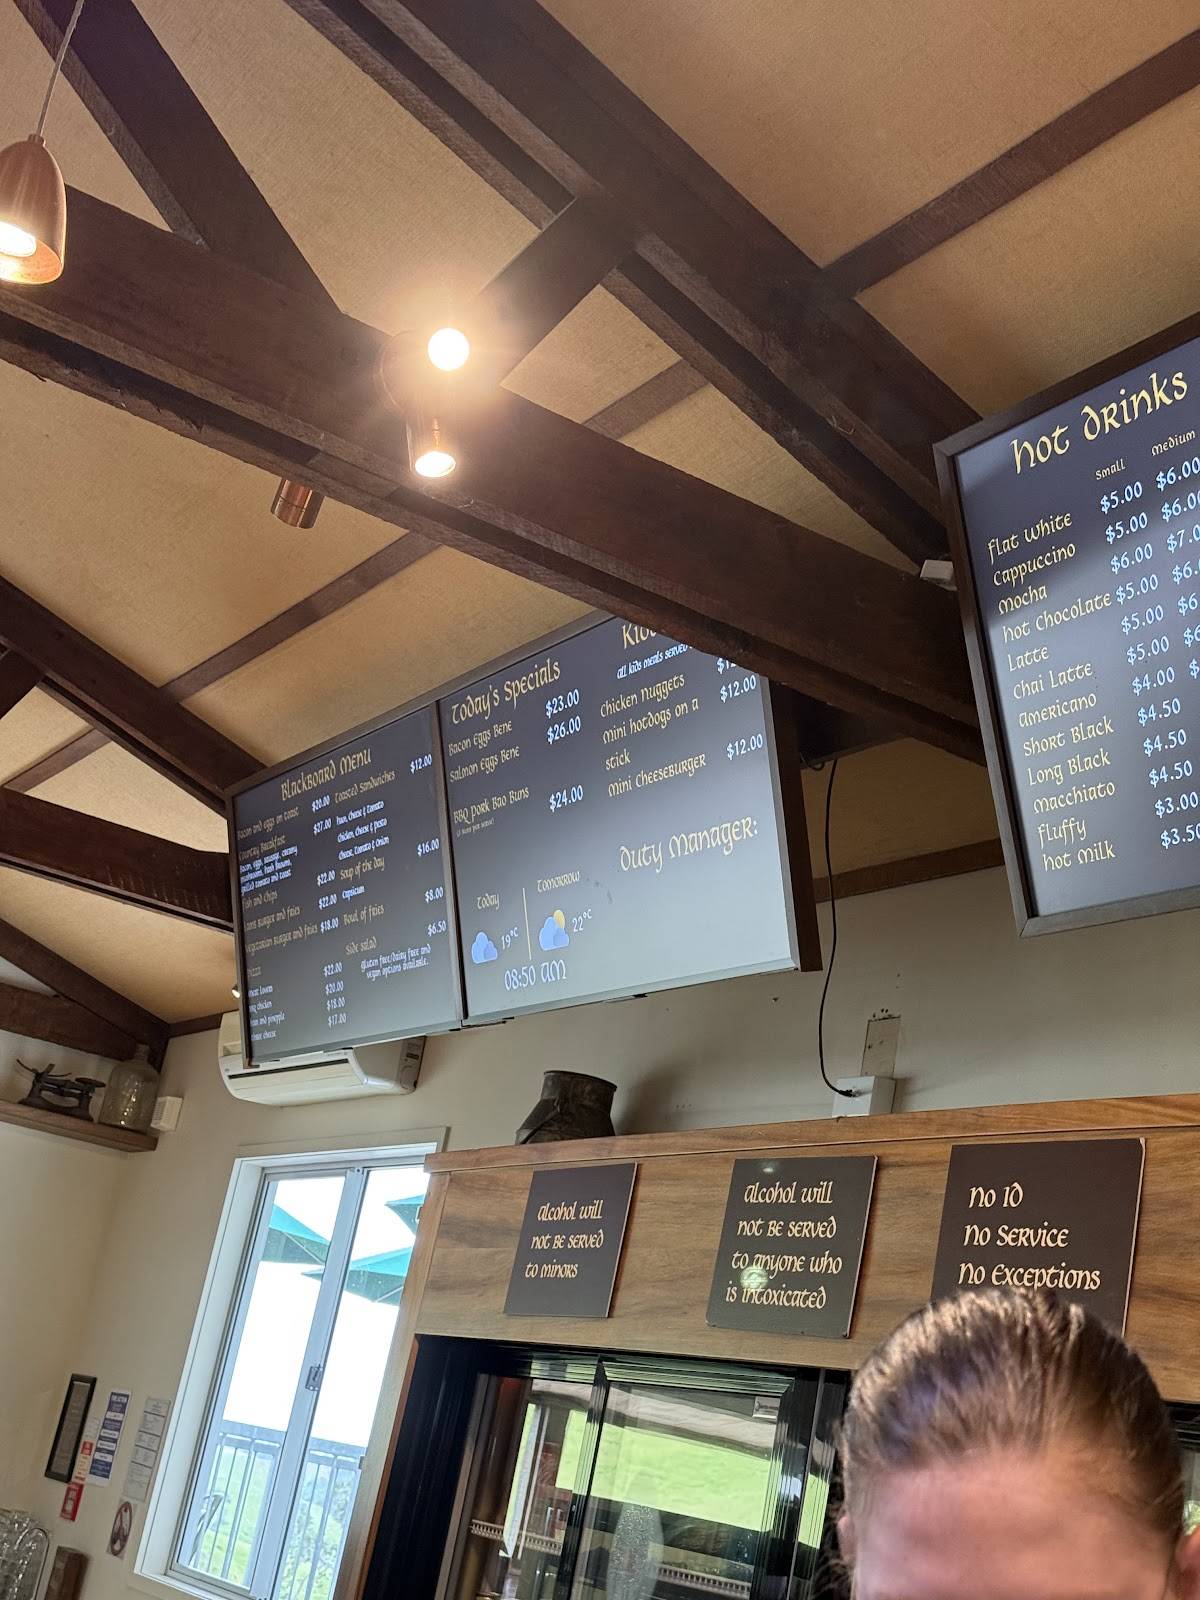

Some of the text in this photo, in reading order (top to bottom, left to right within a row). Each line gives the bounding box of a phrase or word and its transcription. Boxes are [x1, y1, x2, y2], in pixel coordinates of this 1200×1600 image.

[1151, 429, 1196, 457] Medium
[1023, 512, 1073, 544] White
[1100, 481, 1143, 514] $5.00
[993, 542, 1076, 588] Cappuccino
[1105, 512, 1148, 544] $5.00
[998, 542, 1153, 615] Mocha $6.00
[1036, 592, 1112, 633] Chocolate
[1116, 574, 1158, 605] $5.00
[1007, 646, 1049, 672] Latte
[1121, 605, 1164, 635] $5.00
[1013, 636, 1169, 700] Chai Latte $5.00
[1132, 666, 1175, 696] $4.00
[451, 657, 561, 725] Today's Specials
[600, 693, 637, 718] Chicken
[603, 721, 626, 744] Mini
[675, 702, 688, 717] on
[720, 674, 756, 703] $12.00
[448, 737, 471, 756] Bacon
[545, 688, 580, 719] $23.00
[1071, 715, 1114, 744] Black
[1138, 698, 1181, 726] $4.50
[449, 761, 478, 783] Salmon
[547, 715, 581, 745] $26.00
[605, 748, 631, 770] stick
[1028, 729, 1186, 786] Long Black $4.50
[281, 748, 371, 801] Blackboard Menu
[410, 754, 432, 774] $12.00
[608, 733, 763, 797] Mini Cheeseburger $12.00
[1033, 760, 1192, 814] Macchiato $4.50
[453, 808, 471, 824] BBQ
[549, 784, 583, 812] $24.00
[1155, 791, 1198, 818] $3.00
[313, 818, 331, 835] $27.00
[417, 838, 440, 856] $16.00
[619, 815, 759, 873] Duty Manager:
[1078, 839, 1116, 865] Milk
[317, 870, 335, 887] $22.00
[537, 870, 580, 892] Tomorrow
[318, 894, 337, 910] $22.00
[425, 887, 444, 903] $8.00
[320, 917, 338, 934] $18.00
[428, 920, 446, 936] $6.50
[324, 961, 342, 977] $22.00
[505, 965, 536, 990] 08:50
[325, 980, 344, 996] $20.00
[801, 1180, 834, 1204] will
[968, 1186, 996, 1209] No
[579, 1199, 603, 1219] will
[567, 1229, 604, 1249] served
[788, 1216, 837, 1239] served
[963, 1221, 1069, 1248] No Service
[525, 1258, 578, 1278] to minors
[731, 1251, 842, 1280] to anyone who
[958, 1262, 1101, 1290] No Exceptions
[726, 1281, 826, 1310] is intoxicated
